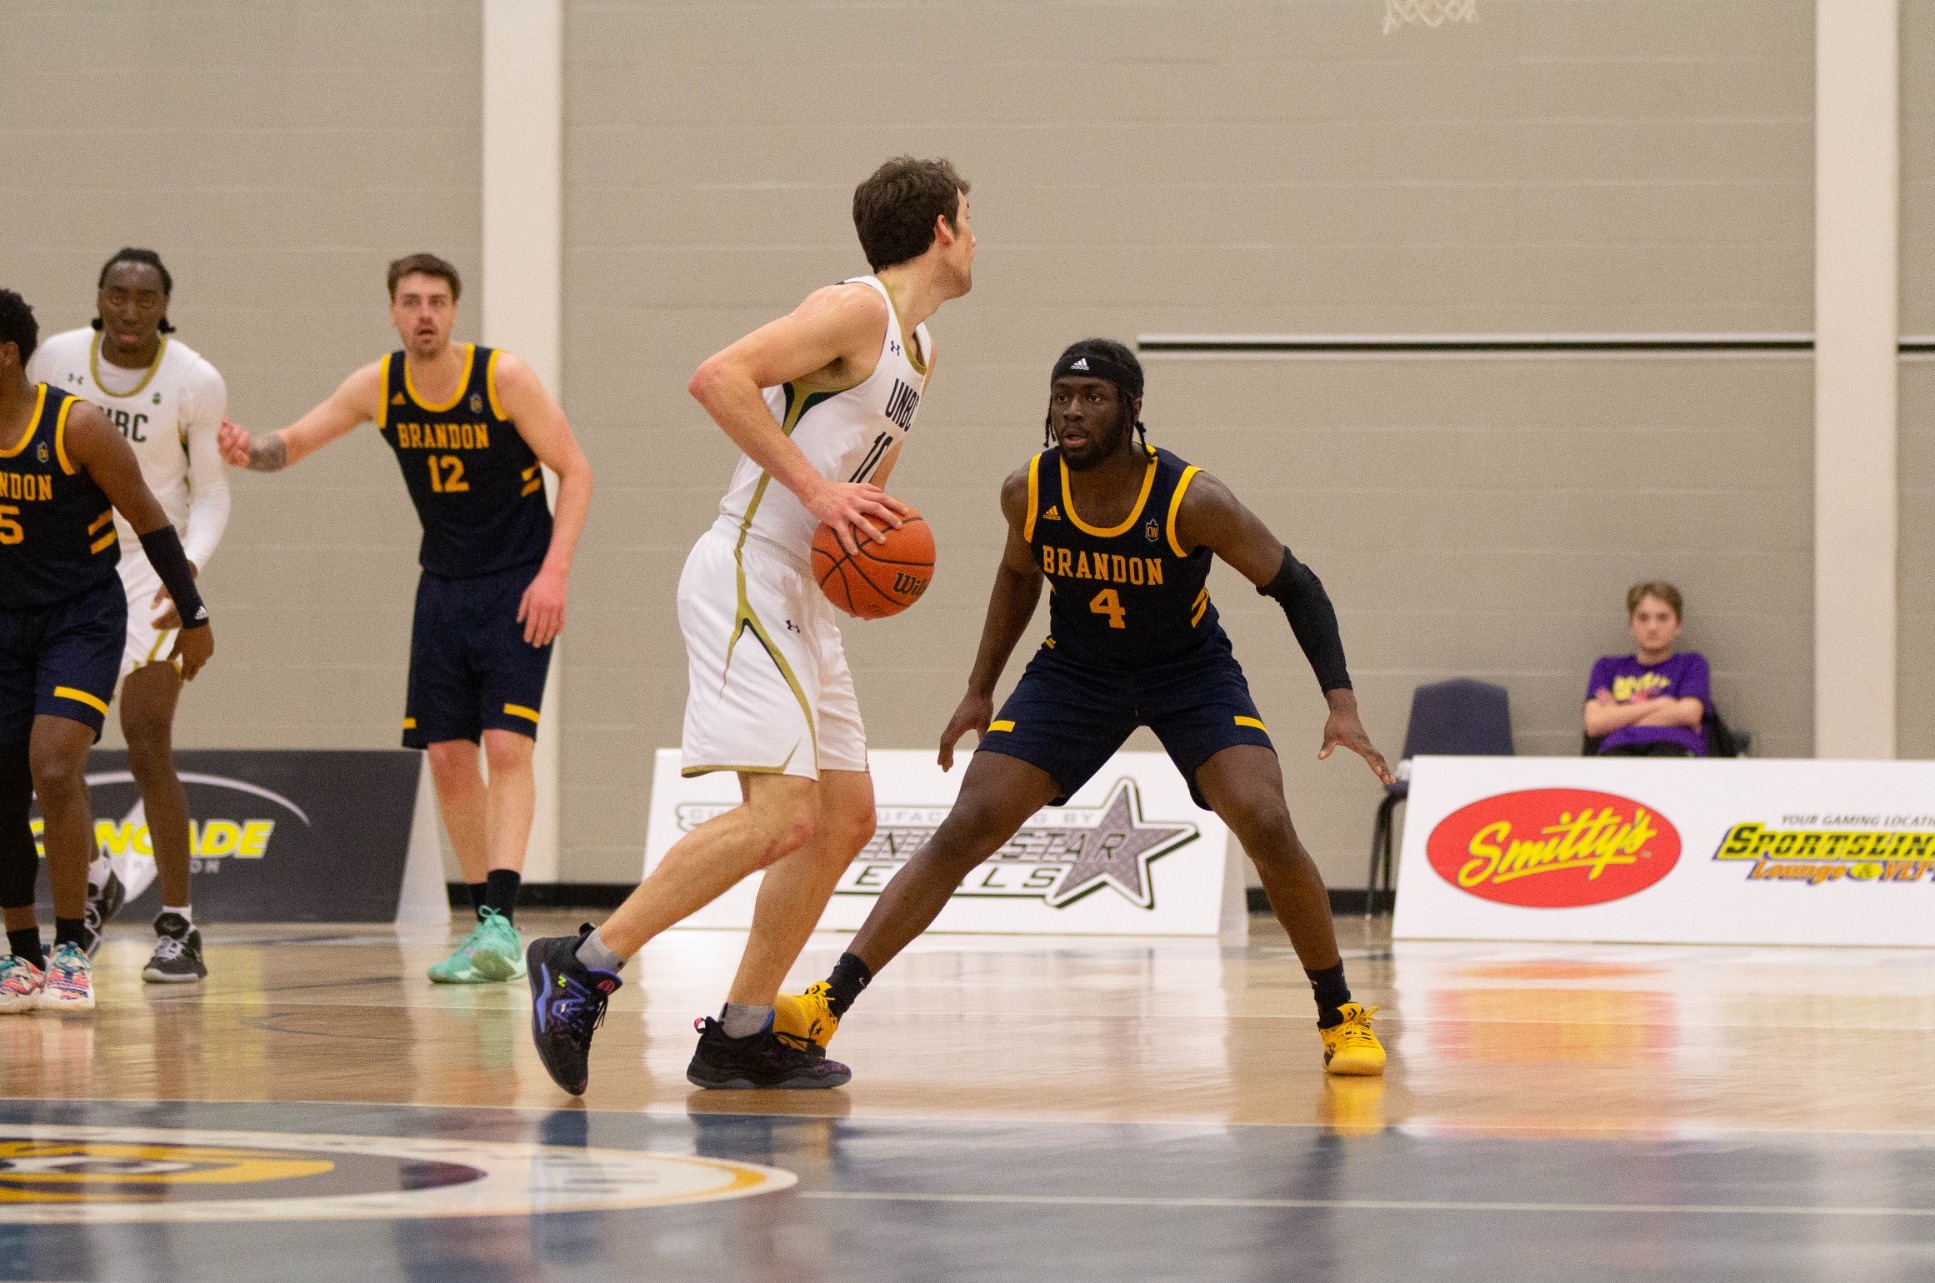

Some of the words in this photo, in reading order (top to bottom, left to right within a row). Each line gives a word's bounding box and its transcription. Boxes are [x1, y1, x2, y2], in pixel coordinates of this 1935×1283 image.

[885, 378, 919, 432] UNBC
[397, 422, 489, 449] BRANDON
[427, 455, 470, 493] 12
[1043, 545, 1164, 585] BRANDON
[1089, 588, 1126, 629] 4
[1782, 815, 1818, 826] YOUR
[1822, 815, 1880, 827] GAMING
[1002, 832, 1127, 860] STAR
[1458, 807, 1658, 887] Smitty's
[1724, 825, 1935, 856] SPORTSLIN
[1750, 859, 1848, 884] Lounge
